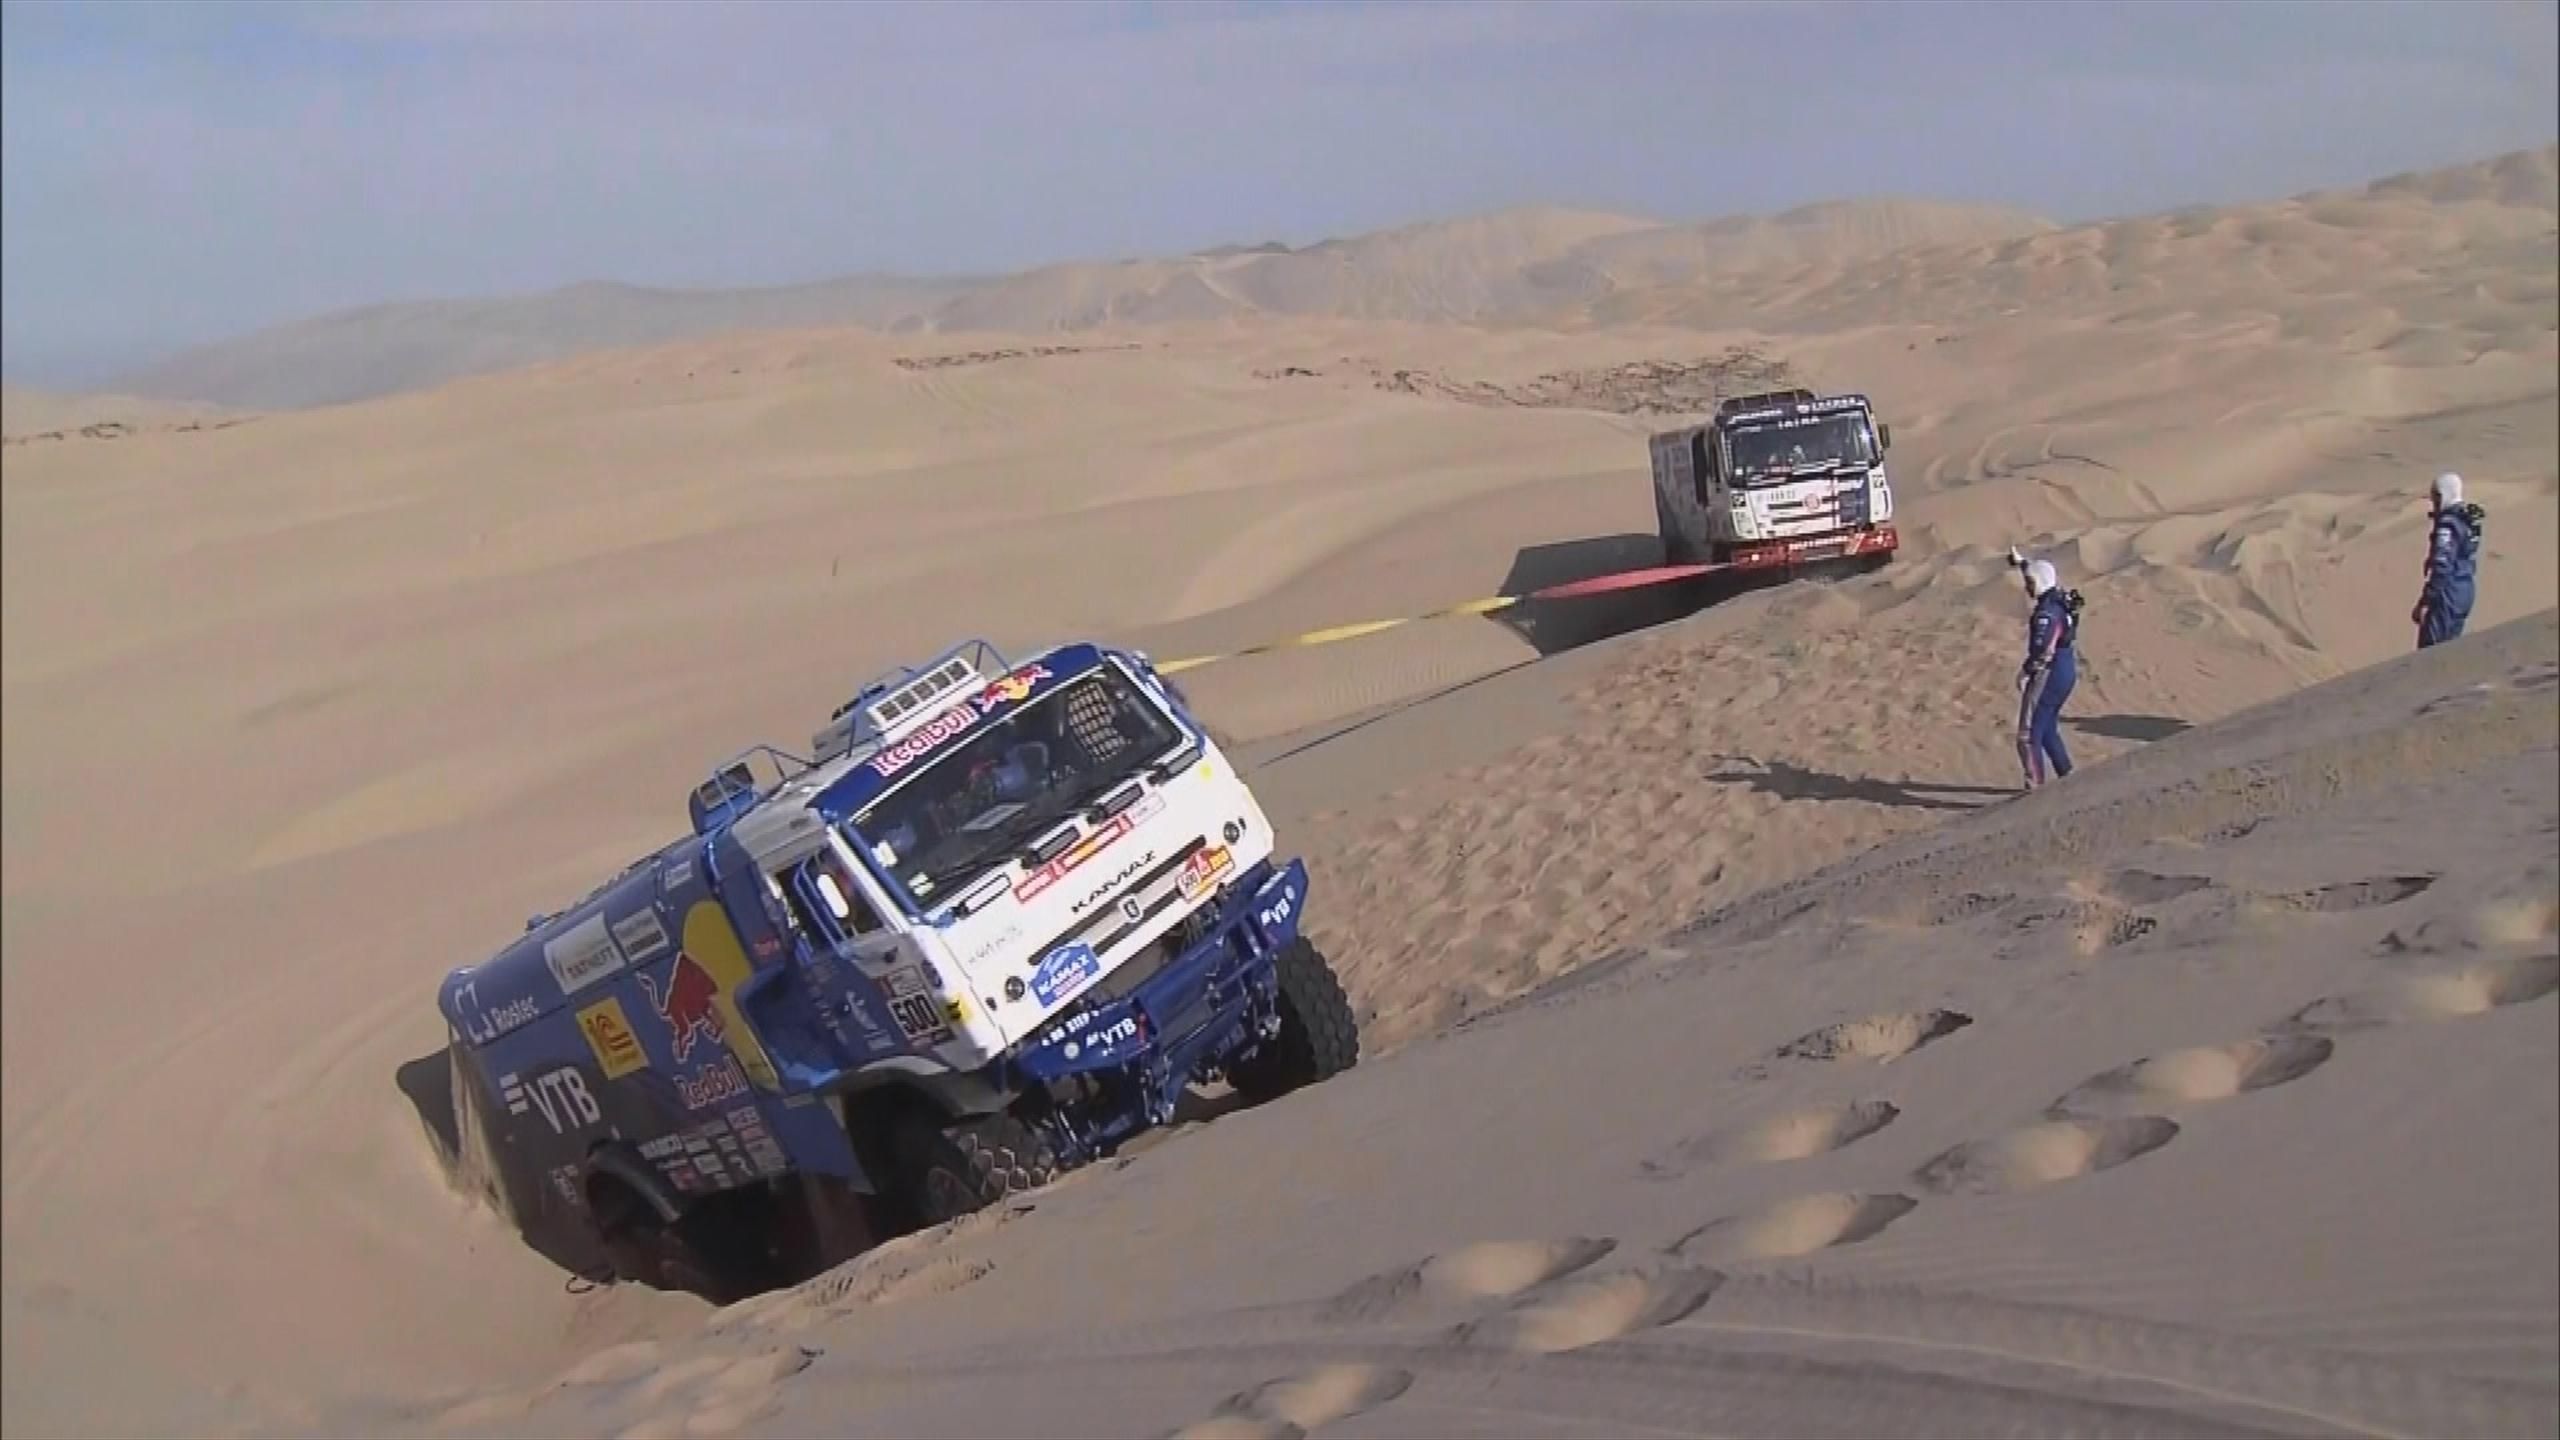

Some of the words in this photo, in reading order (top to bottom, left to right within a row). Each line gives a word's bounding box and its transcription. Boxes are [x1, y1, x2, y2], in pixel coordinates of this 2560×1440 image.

[892, 994, 941, 1036] 500
[1101, 1017, 1138, 1046] VTB
[524, 1066, 601, 1134] VTB
